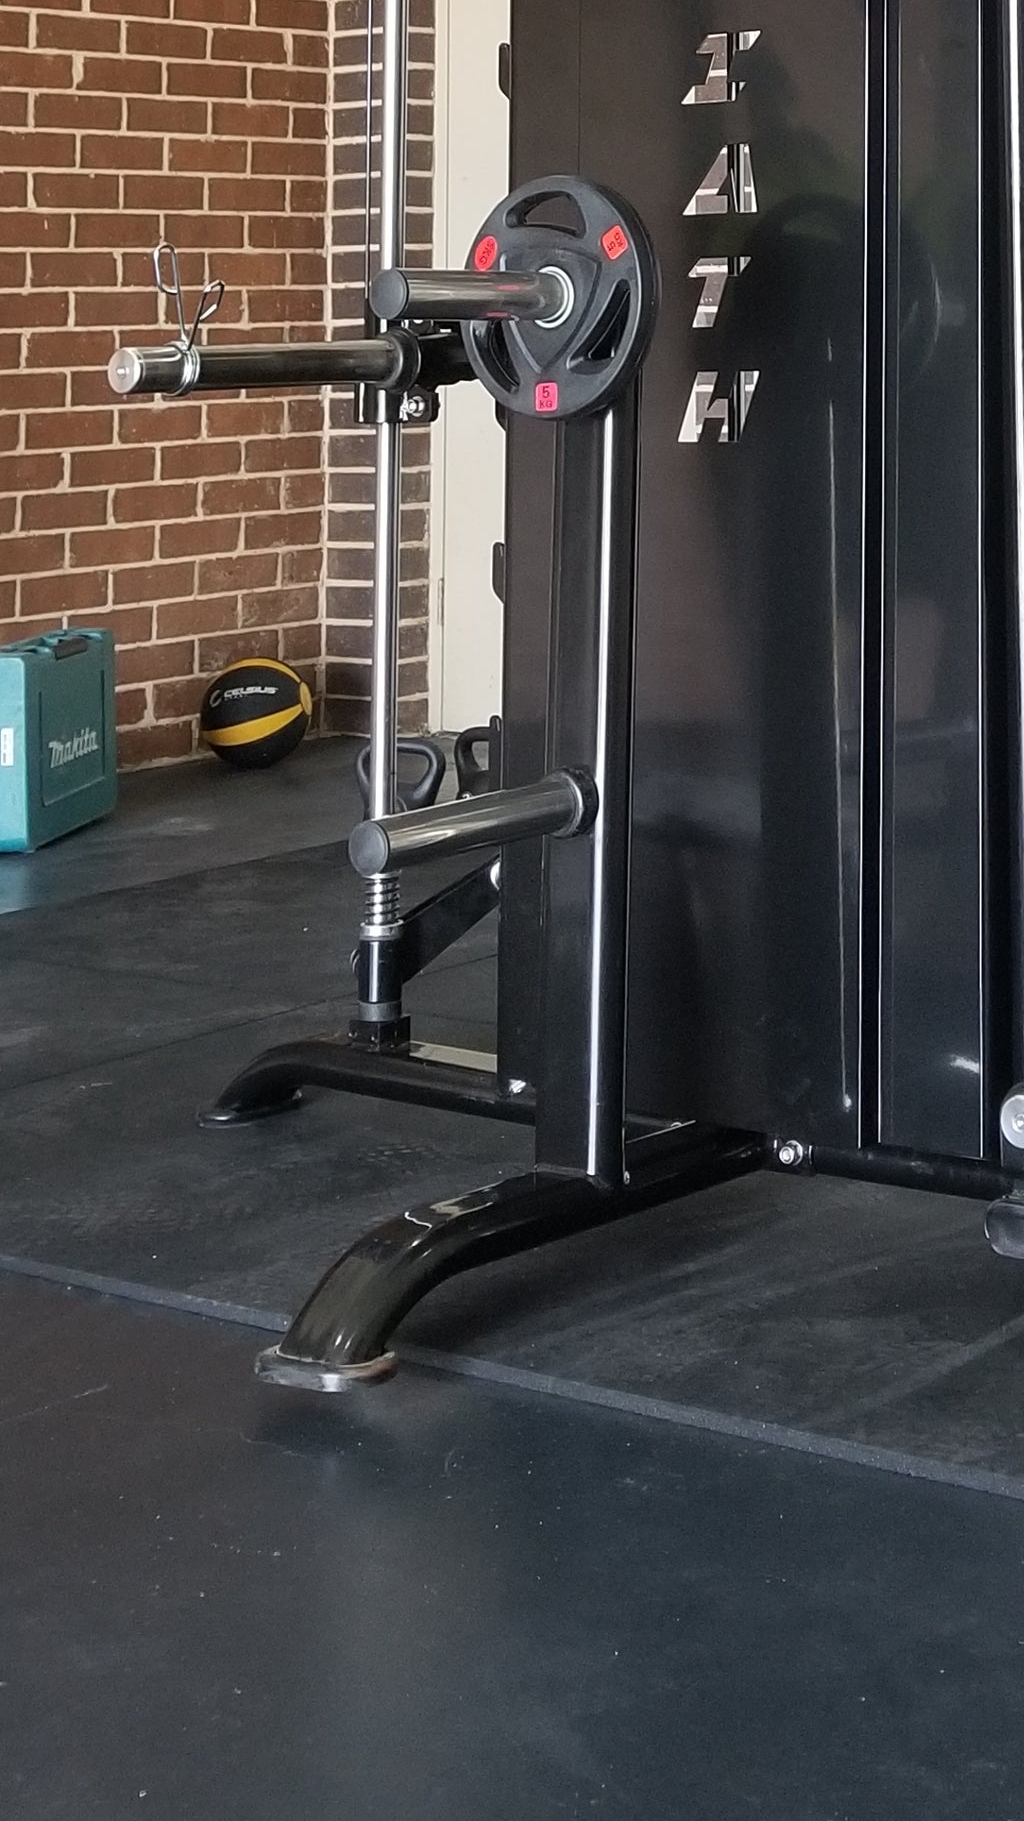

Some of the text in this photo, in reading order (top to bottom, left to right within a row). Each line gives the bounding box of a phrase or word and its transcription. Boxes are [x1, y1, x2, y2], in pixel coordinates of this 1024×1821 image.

[542, 385, 550, 399] 5
[539, 400, 553, 409] KG
[223, 686, 279, 698] CELSIUS
